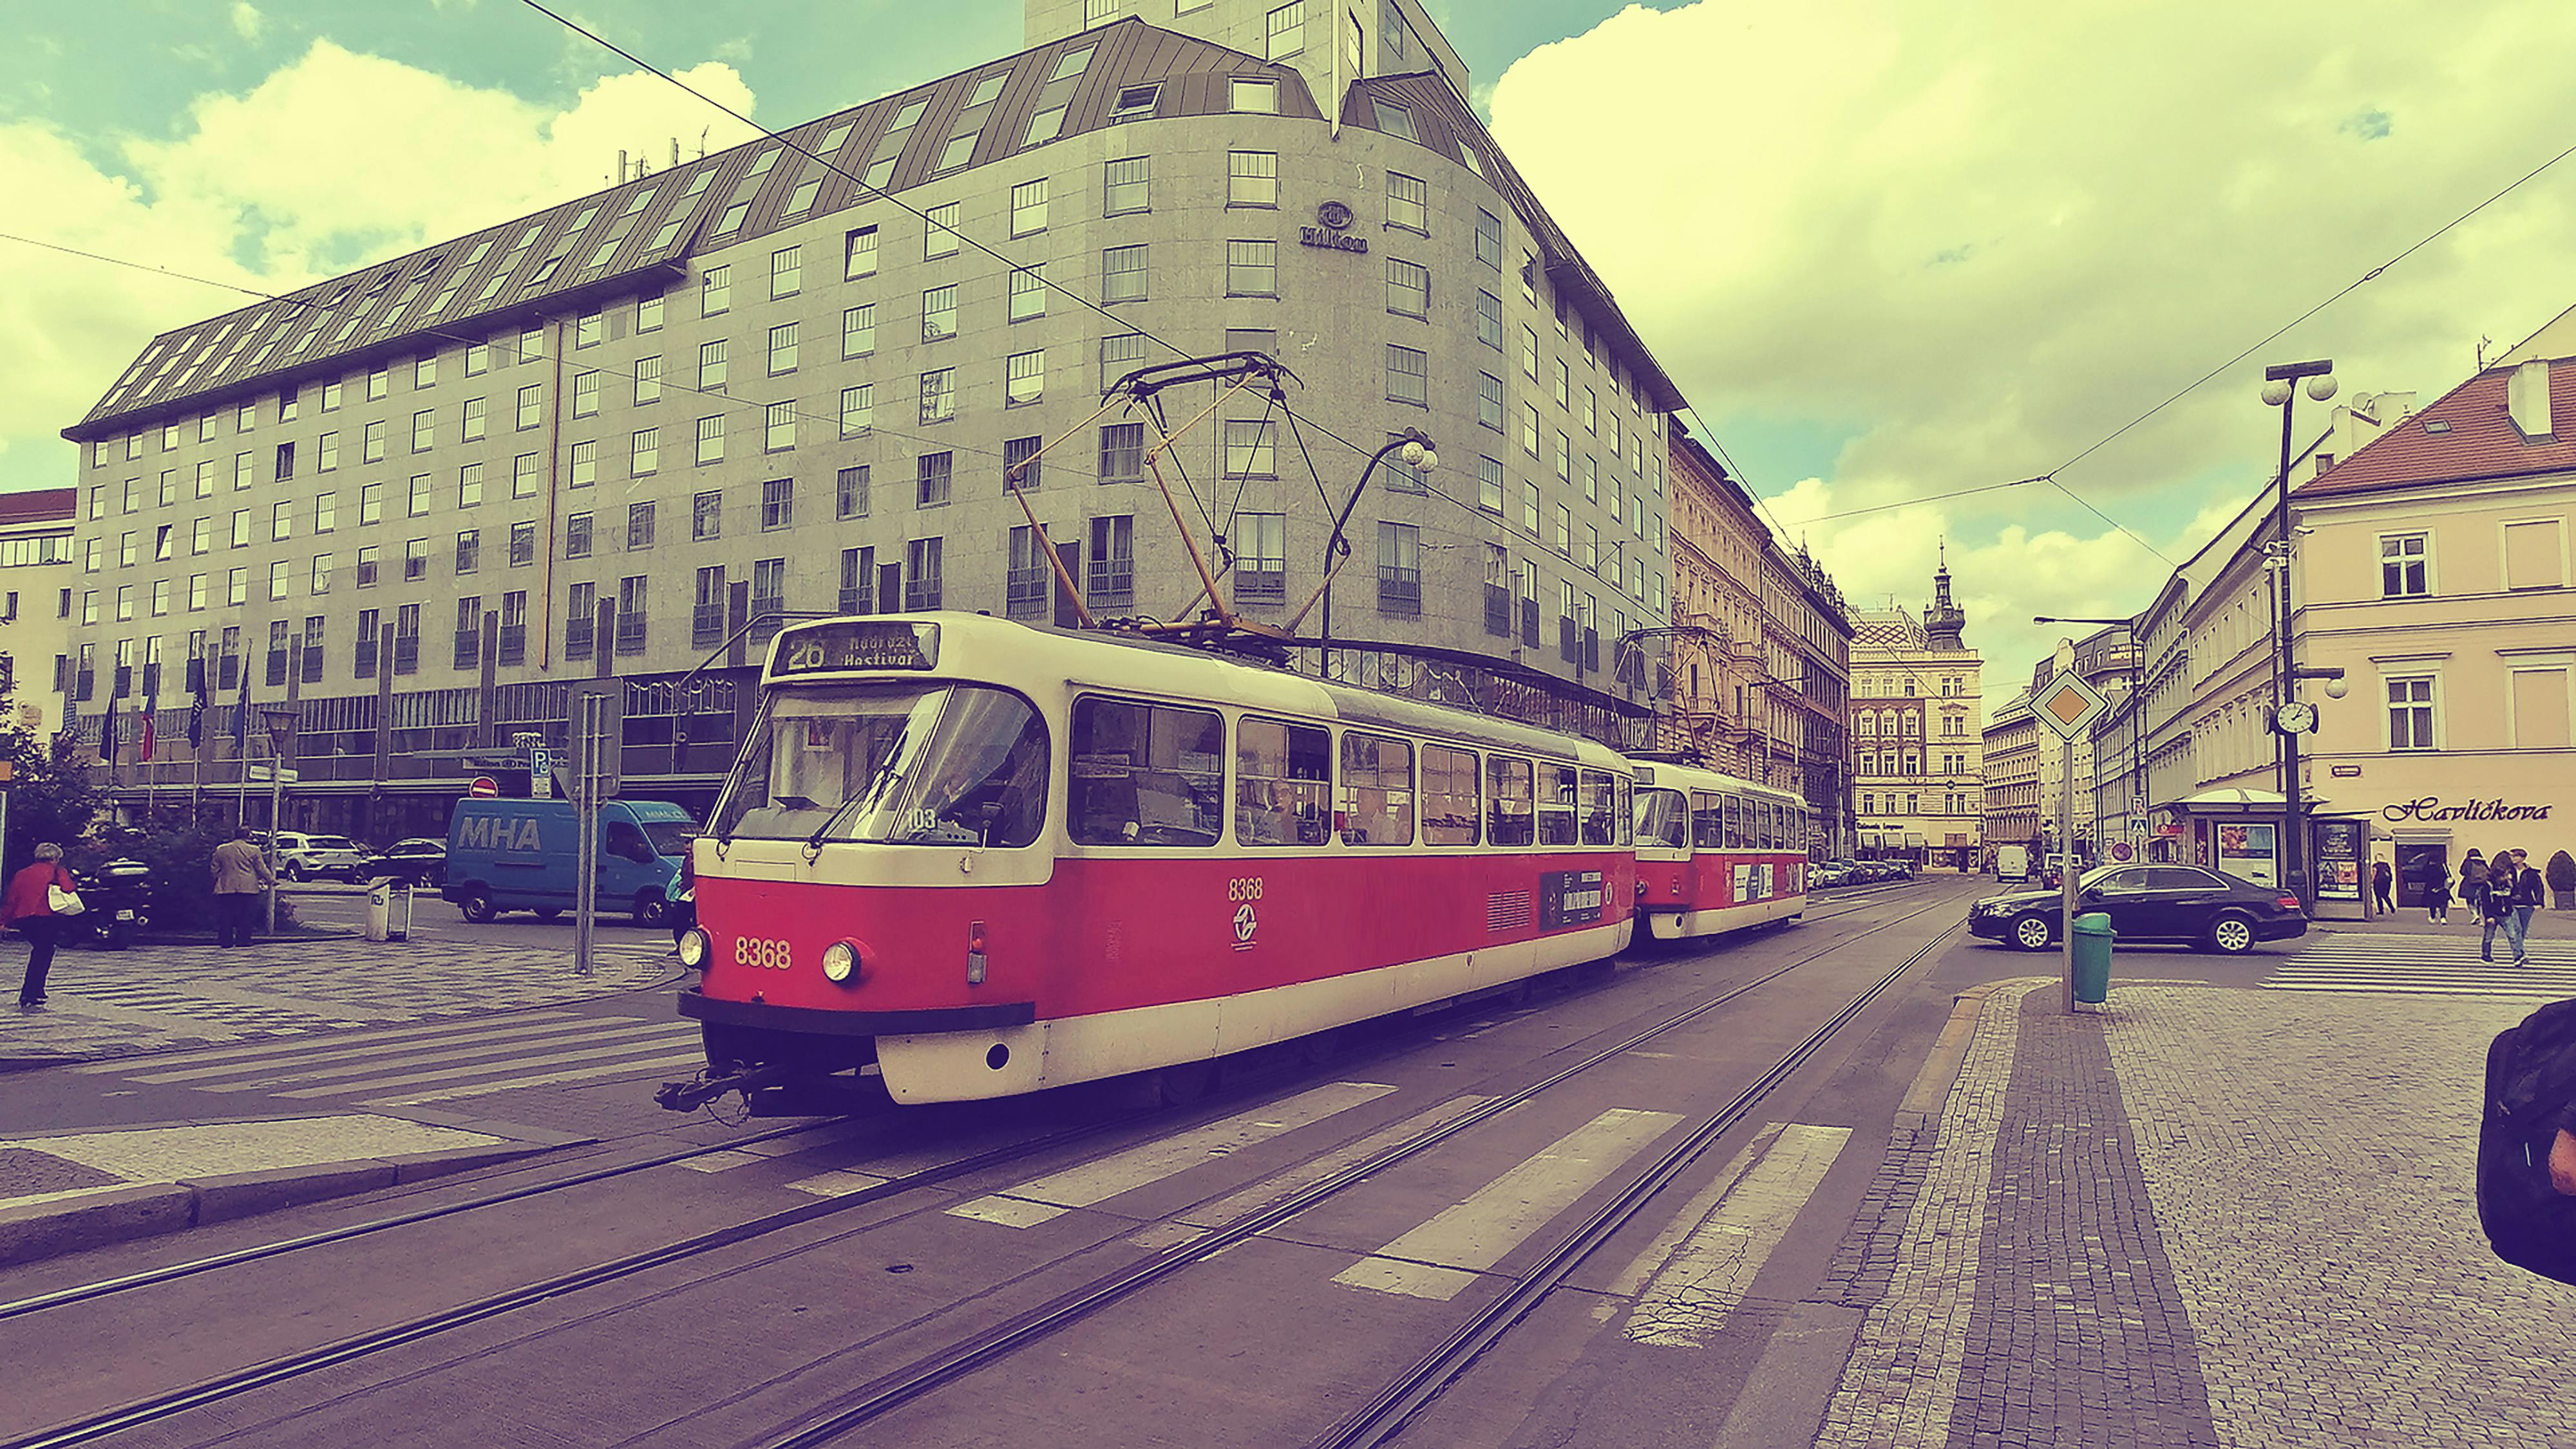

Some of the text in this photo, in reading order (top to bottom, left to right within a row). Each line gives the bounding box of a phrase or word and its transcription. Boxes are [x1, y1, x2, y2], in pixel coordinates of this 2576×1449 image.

[1300, 226, 1369, 254] Hilton
[535, 752, 546, 768] P
[2382, 796, 2552, 822] Havlíčkova
[457, 817, 540, 850] MHA
[1228, 876, 1263, 902] 8368
[735, 936, 791, 970] 8368
